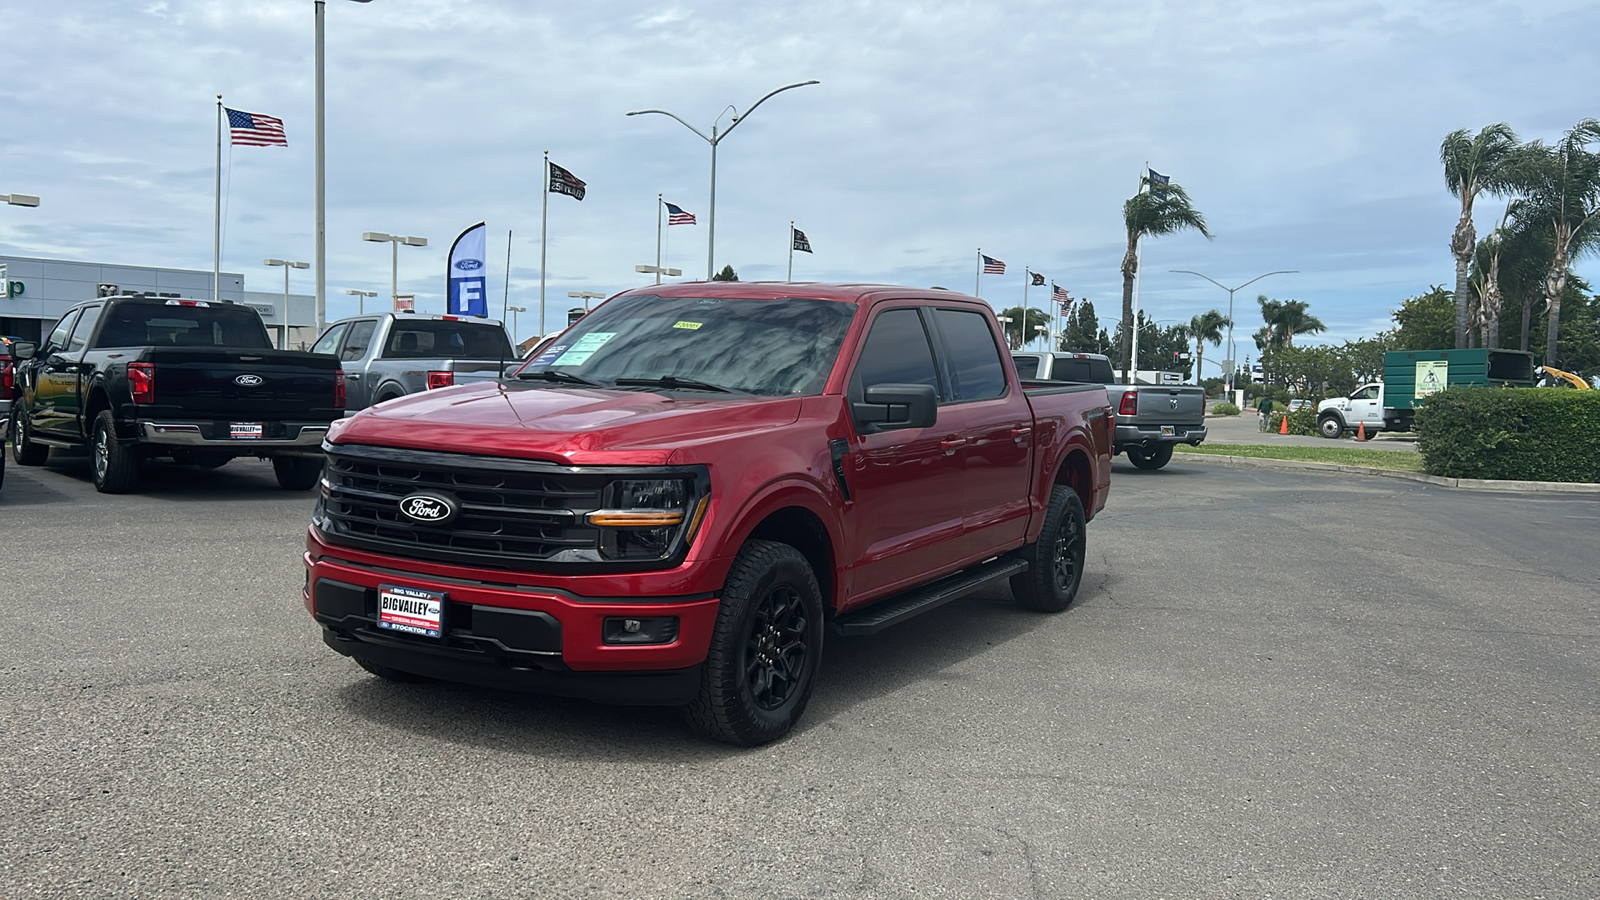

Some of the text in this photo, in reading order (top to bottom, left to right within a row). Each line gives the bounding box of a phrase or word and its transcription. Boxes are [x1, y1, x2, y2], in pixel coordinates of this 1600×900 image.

[459, 260, 480, 270] Ford
[460, 281, 481, 312] F
[240, 376, 259, 384] Ford
[407, 498, 442, 518] Ford
[405, 590, 428, 598] VALLEY
[382, 596, 428, 616] BIGVALLEY
[392, 624, 426, 634] STOCKTON
